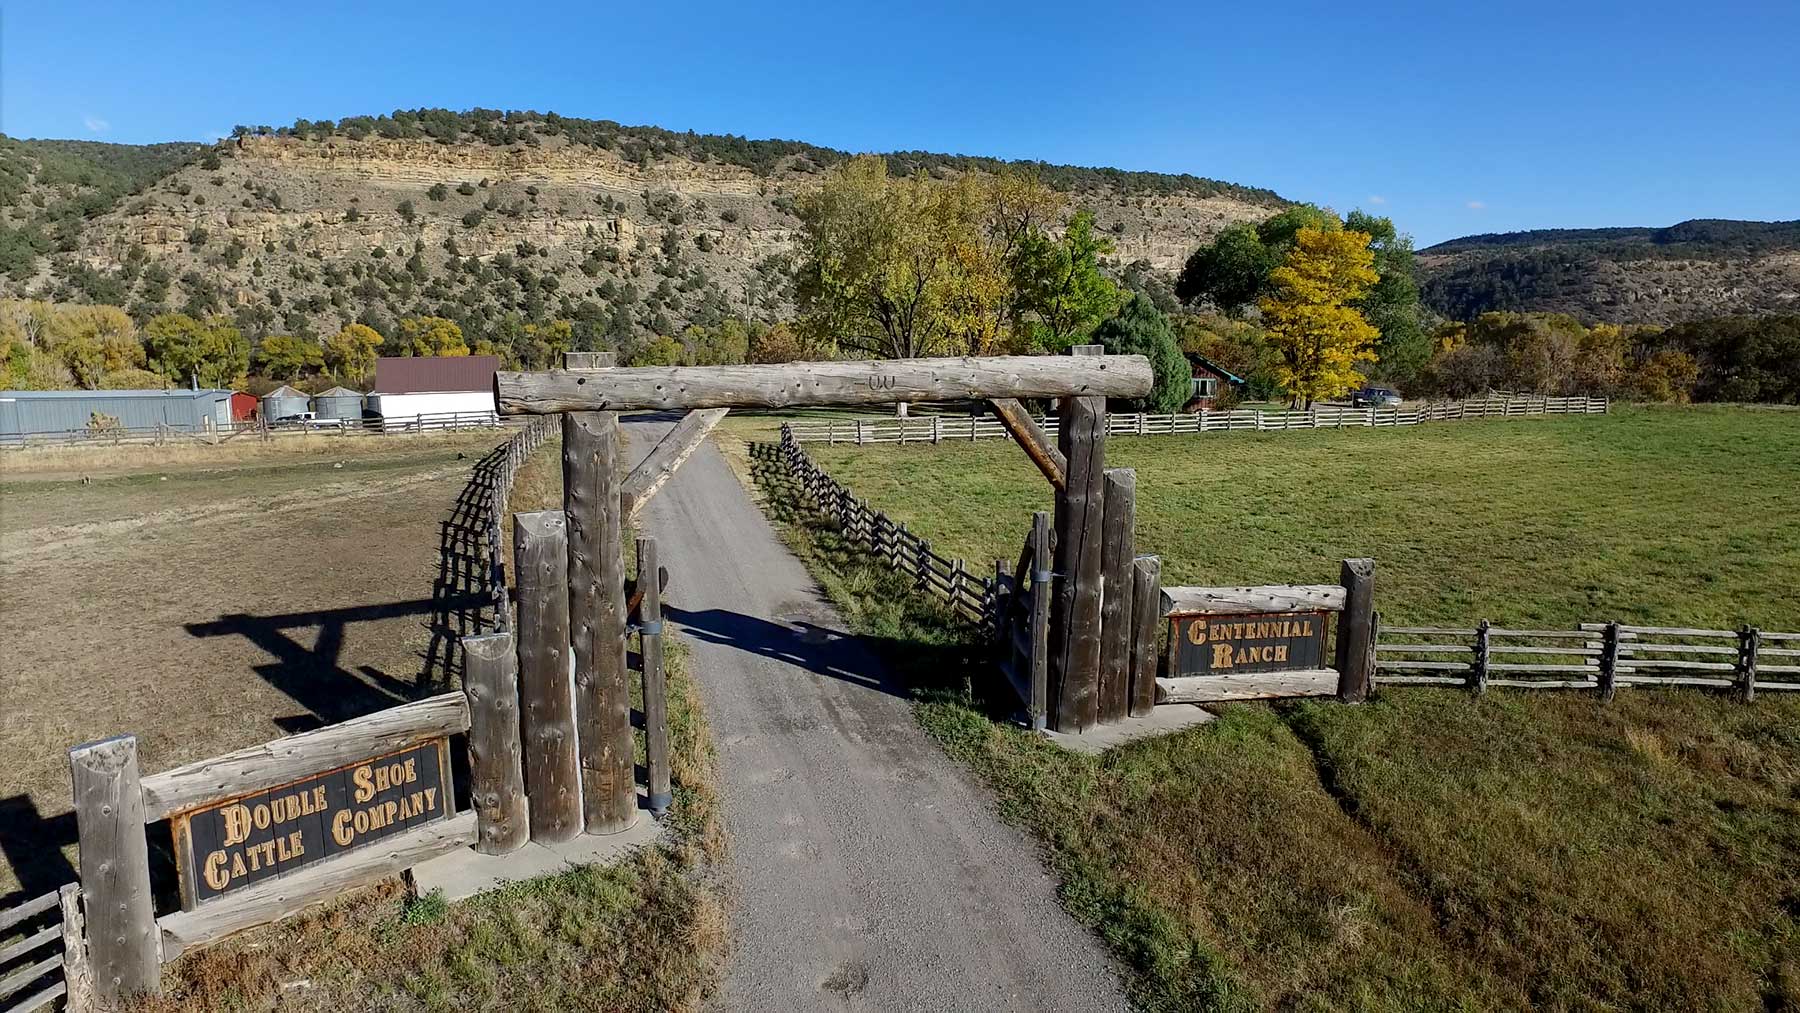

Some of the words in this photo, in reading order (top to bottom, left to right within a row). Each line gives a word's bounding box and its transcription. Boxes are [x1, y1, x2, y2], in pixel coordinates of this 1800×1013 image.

[1187, 619, 1313, 645] CENTENNIAL
[1210, 643, 1288, 669] RANCH
[220, 784, 328, 847] DOUBLE
[352, 757, 417, 804] SHOE
[203, 829, 305, 890] CATTLE
[331, 787, 437, 846] COMPANY
